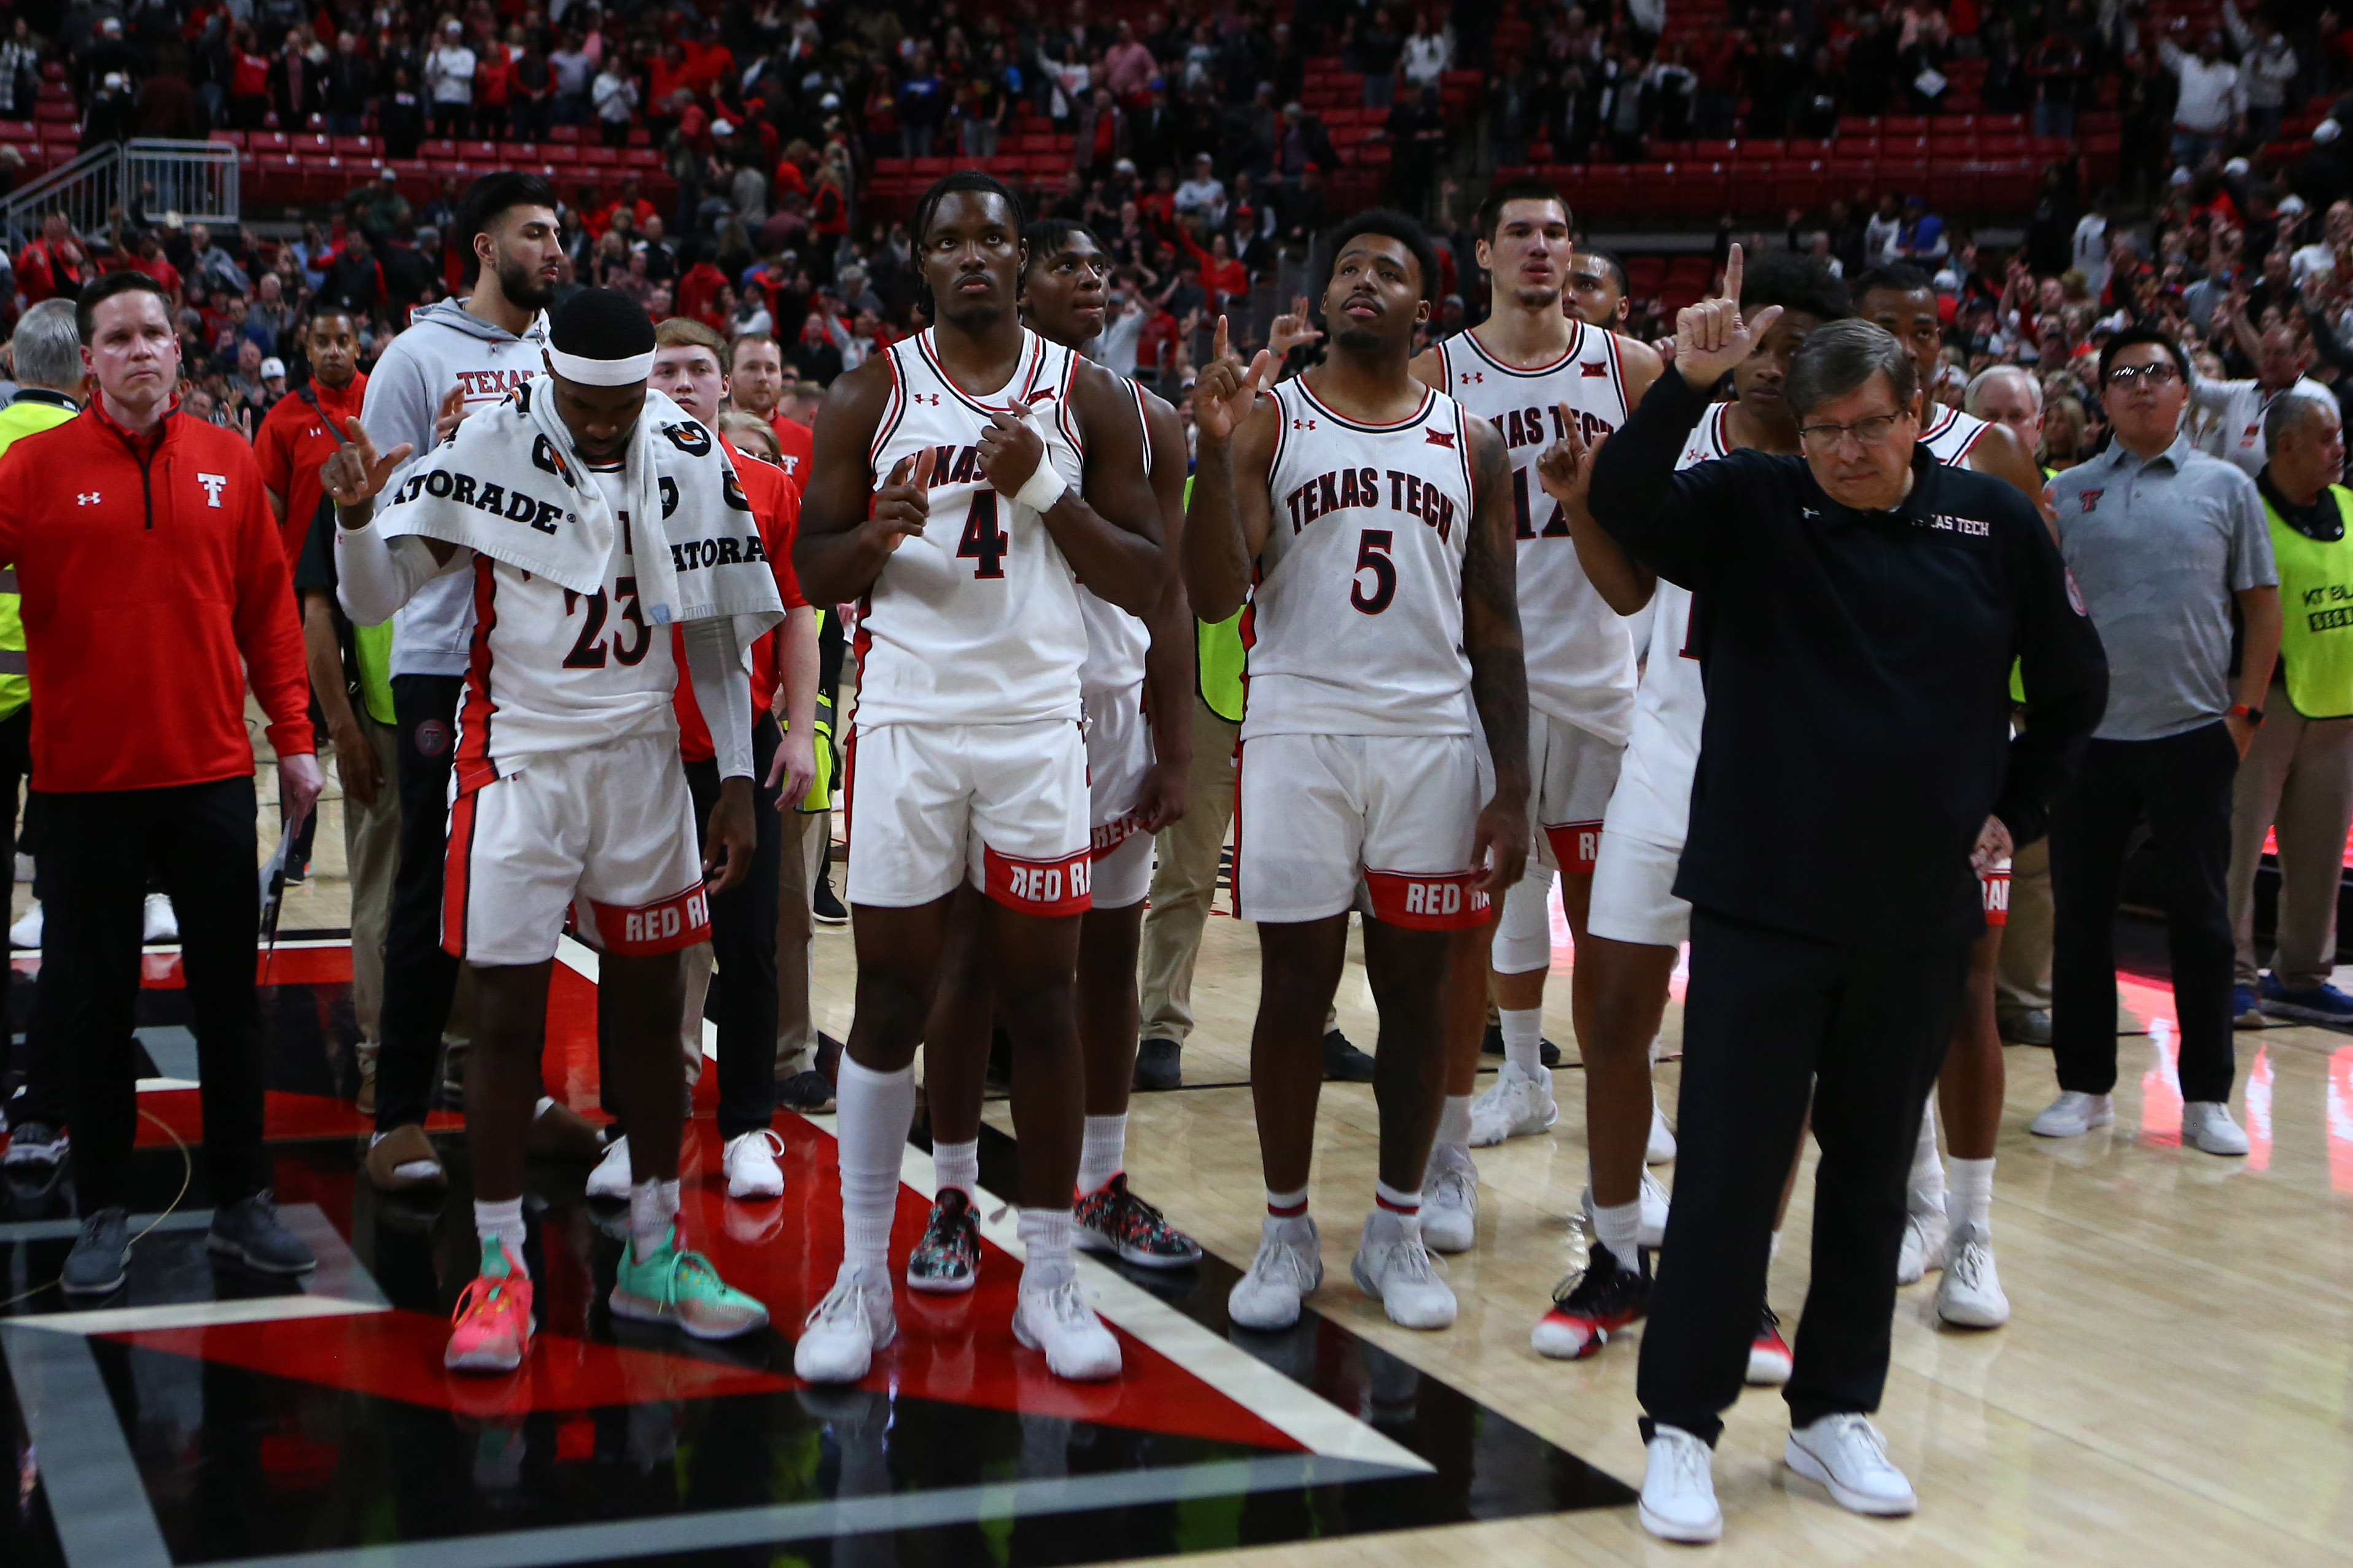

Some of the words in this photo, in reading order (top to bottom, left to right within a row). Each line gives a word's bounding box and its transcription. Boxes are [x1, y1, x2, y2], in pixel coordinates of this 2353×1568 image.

[956, 489, 1008, 580] 4
[1287, 467, 1379, 536] TEXAS
[1387, 470, 1454, 545] TECH
[1956, 517, 1989, 536] TECH
[1350, 529, 1396, 615] 5
[562, 576, 651, 668] 23
[1009, 866, 1062, 902] RED
[1406, 882, 1460, 915] RED
[625, 907, 680, 942] RED
